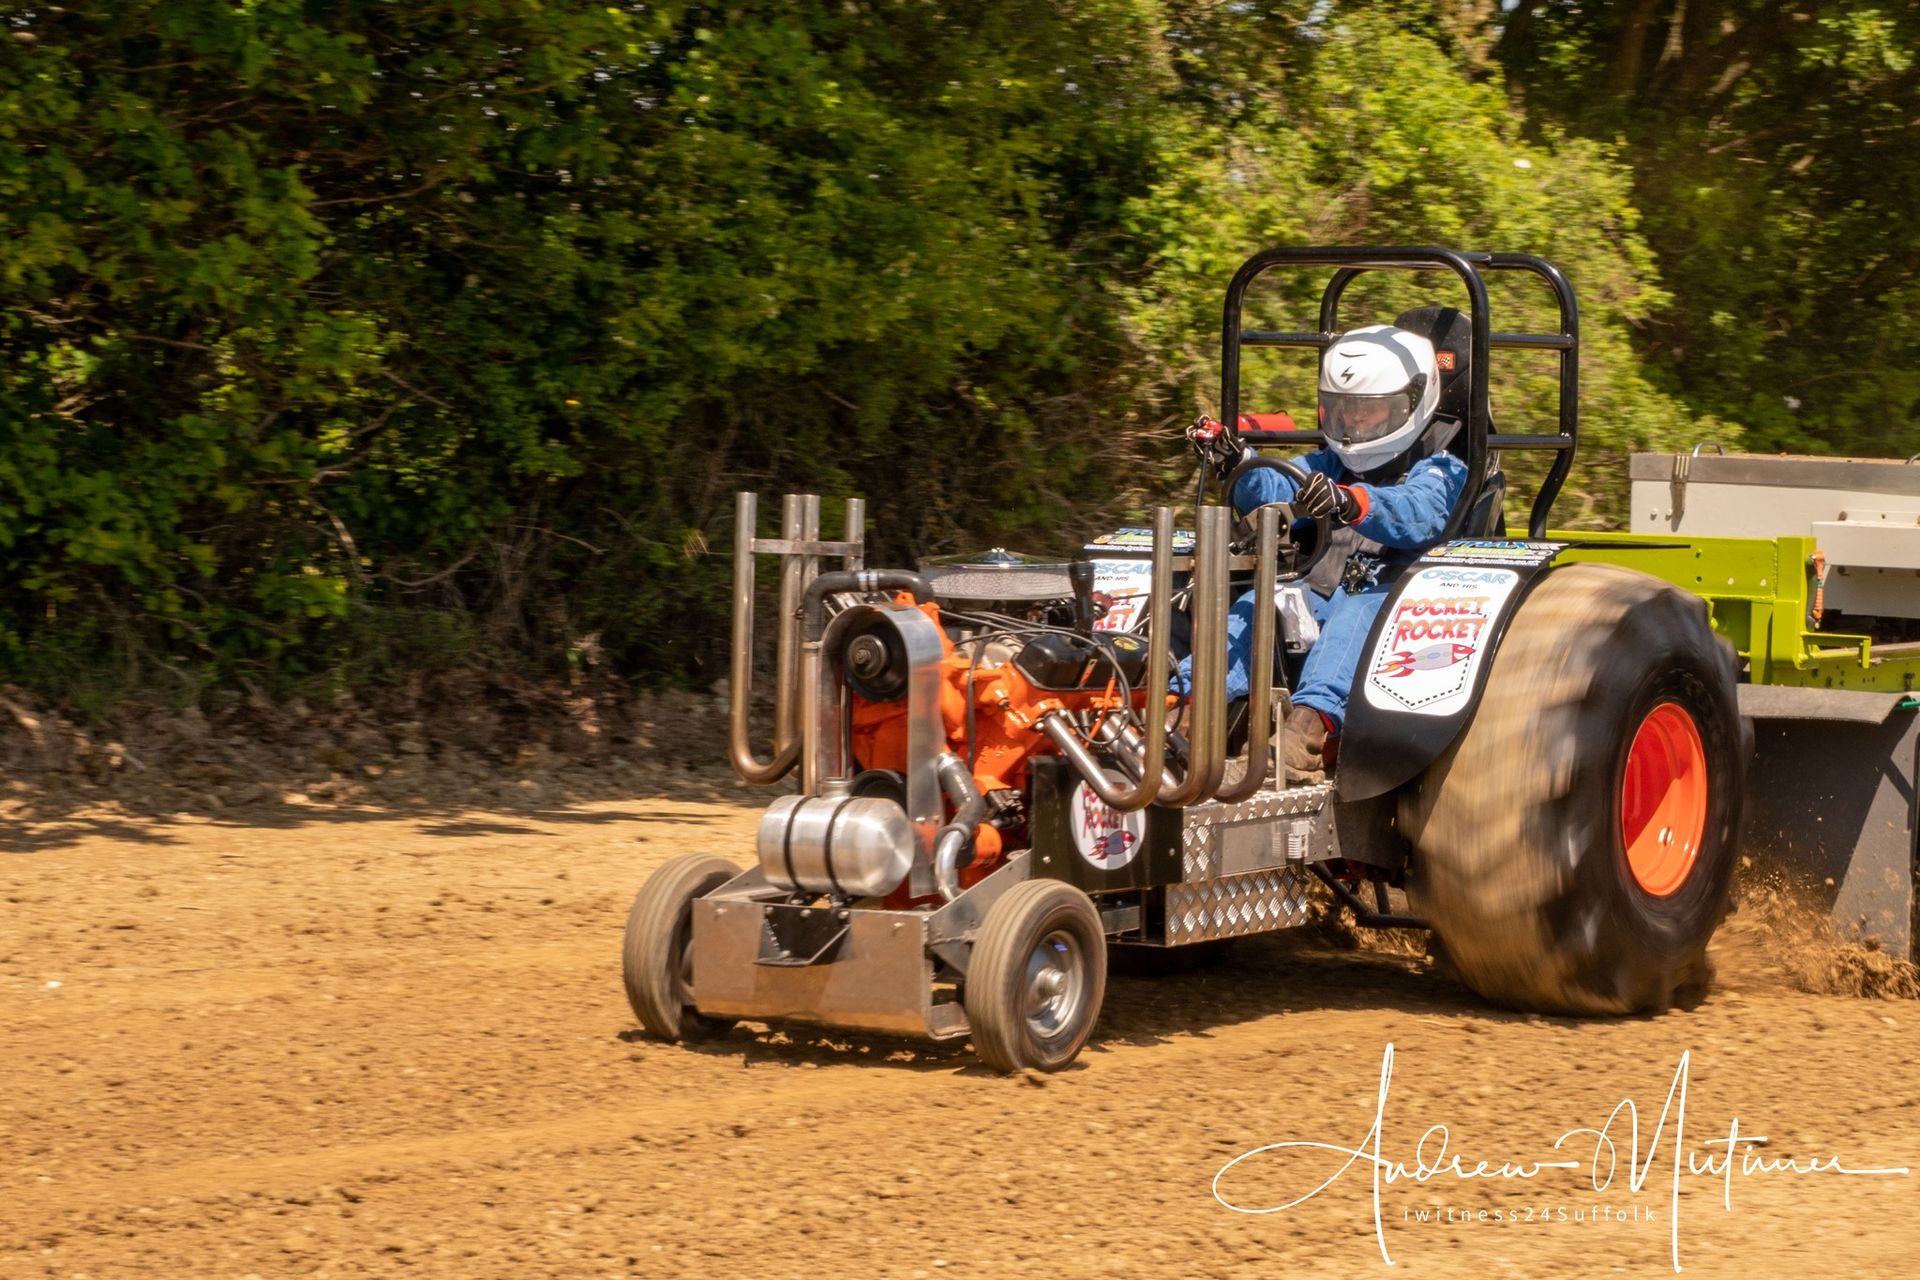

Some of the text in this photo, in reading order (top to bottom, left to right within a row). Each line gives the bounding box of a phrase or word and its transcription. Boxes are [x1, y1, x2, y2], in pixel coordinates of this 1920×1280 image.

[1422, 569, 1512, 585] OSCAR
[1393, 596, 1490, 624] POCKET
[1392, 617, 1488, 652] ROCKET
